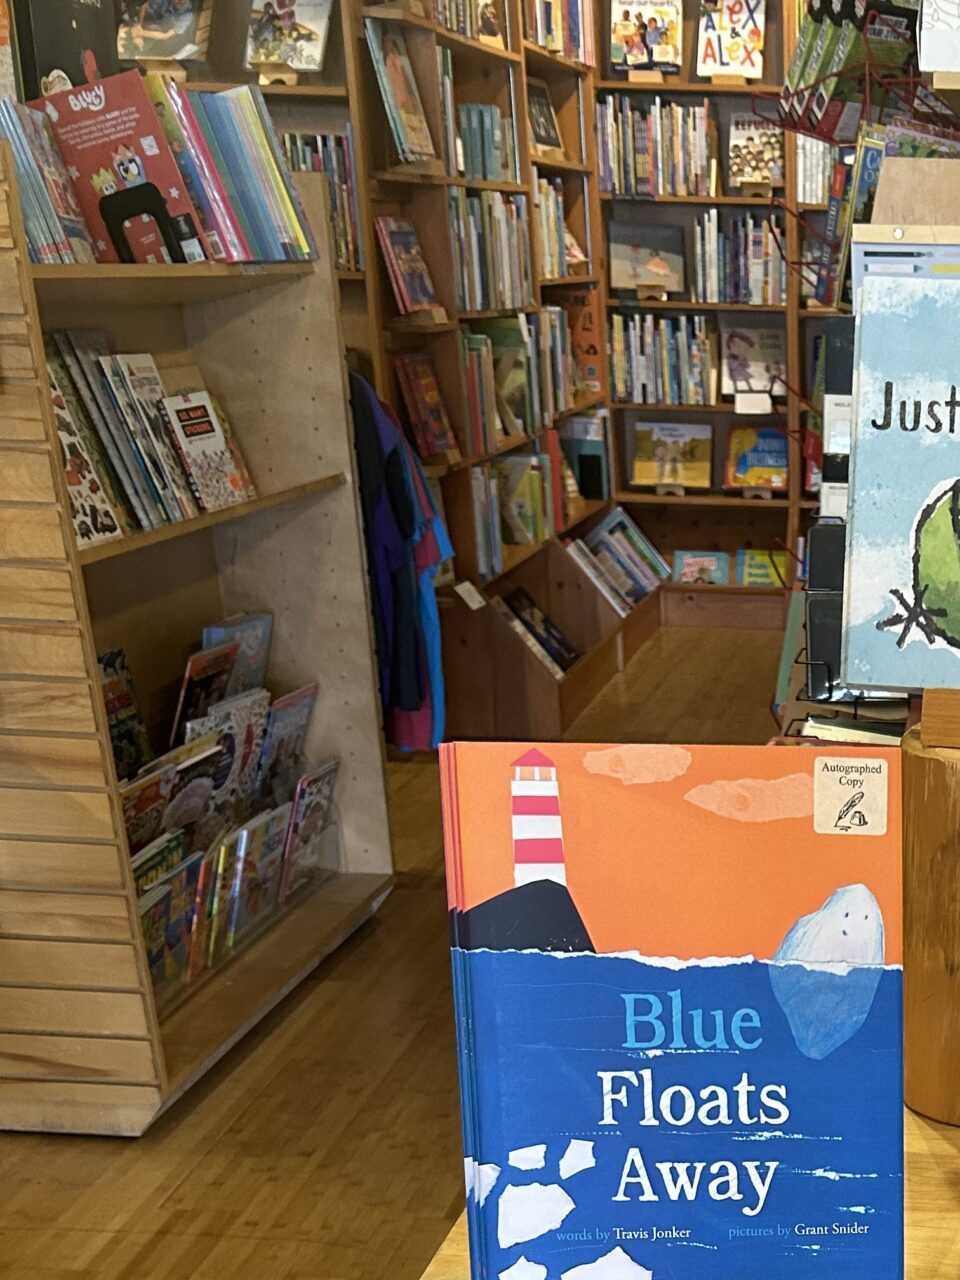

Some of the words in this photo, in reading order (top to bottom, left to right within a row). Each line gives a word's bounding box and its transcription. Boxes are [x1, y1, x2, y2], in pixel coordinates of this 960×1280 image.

[822, 762, 882, 776] Autographed
[839, 776, 864, 789] Copy
[619, 988, 764, 1051] Blue
[596, 1068, 791, 1127] Floats
[611, 1146, 780, 1218] Away
[556, 1228, 592, 1241] words
[596, 1228, 610, 1244] by
[613, 1227, 649, 1240] Travis
[651, 1225, 692, 1242] Jonker
[728, 1225, 774, 1240] pictures
[777, 1224, 792, 1239] by
[794, 1223, 829, 1236] Grant
[832, 1221, 870, 1235] Snider
